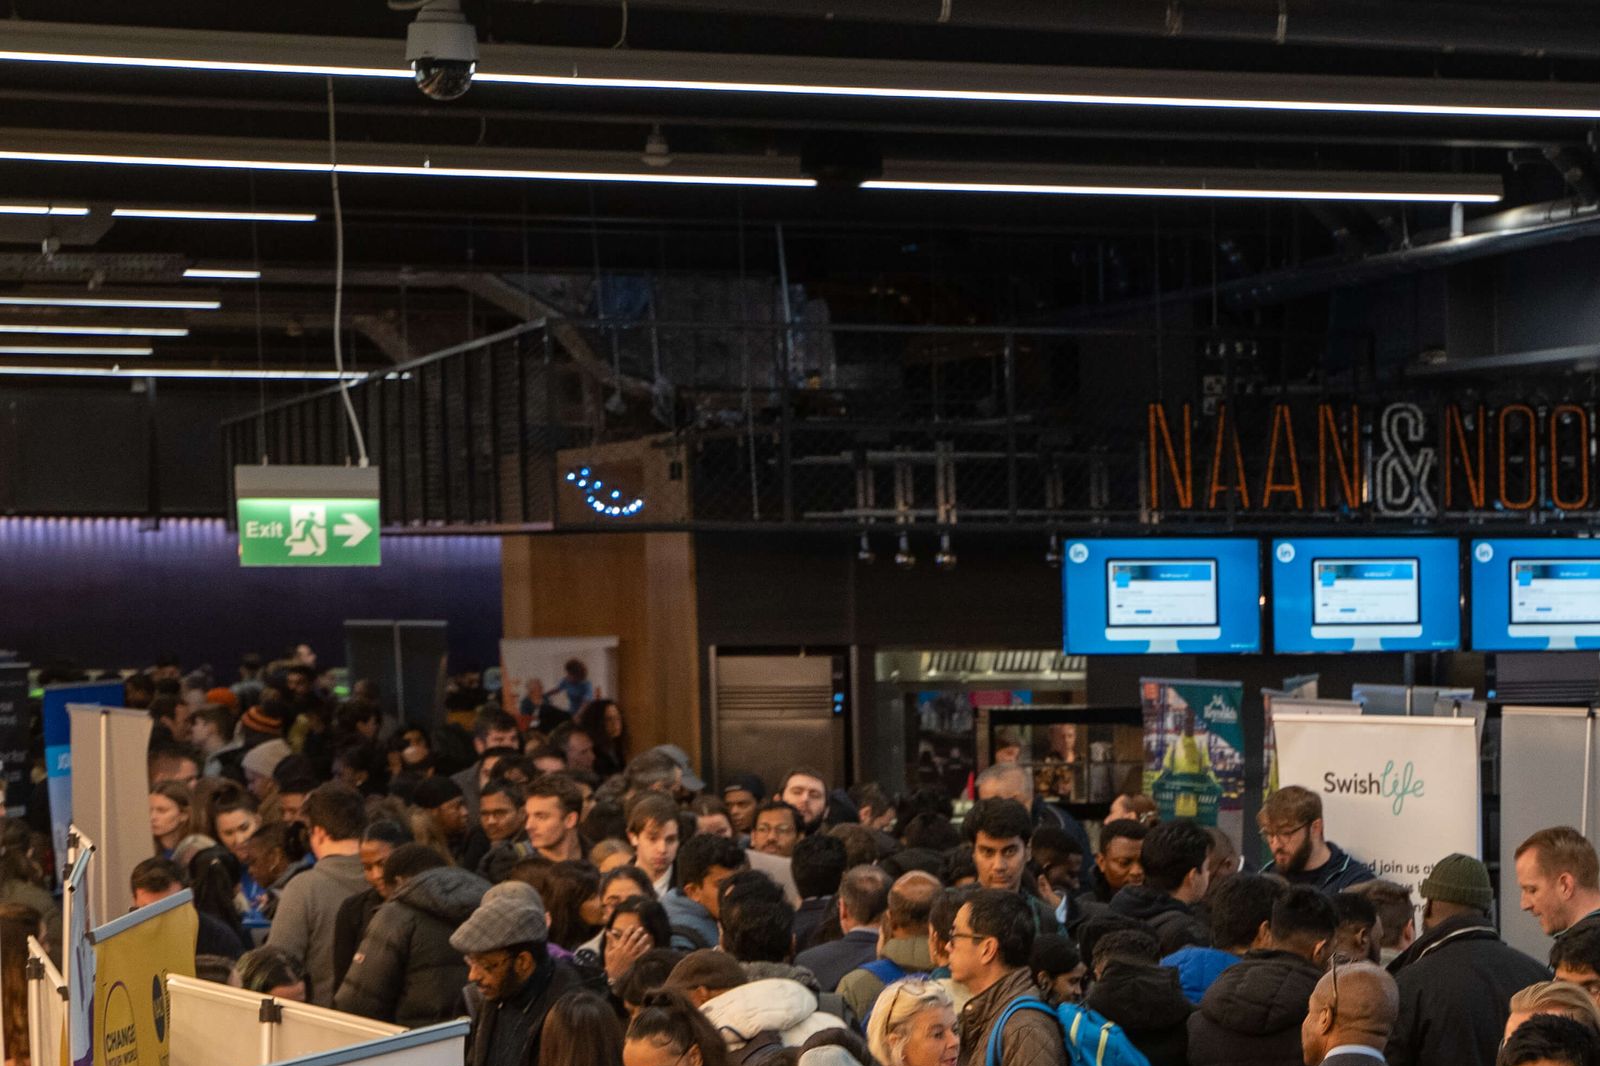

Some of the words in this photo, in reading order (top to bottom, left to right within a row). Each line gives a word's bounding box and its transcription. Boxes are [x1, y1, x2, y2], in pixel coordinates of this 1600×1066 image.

[245, 520, 284, 538] Exit
[1379, 860, 1403, 876] join
[1406, 862, 1420, 874] us
[105, 1023, 137, 1053] CHANGE
